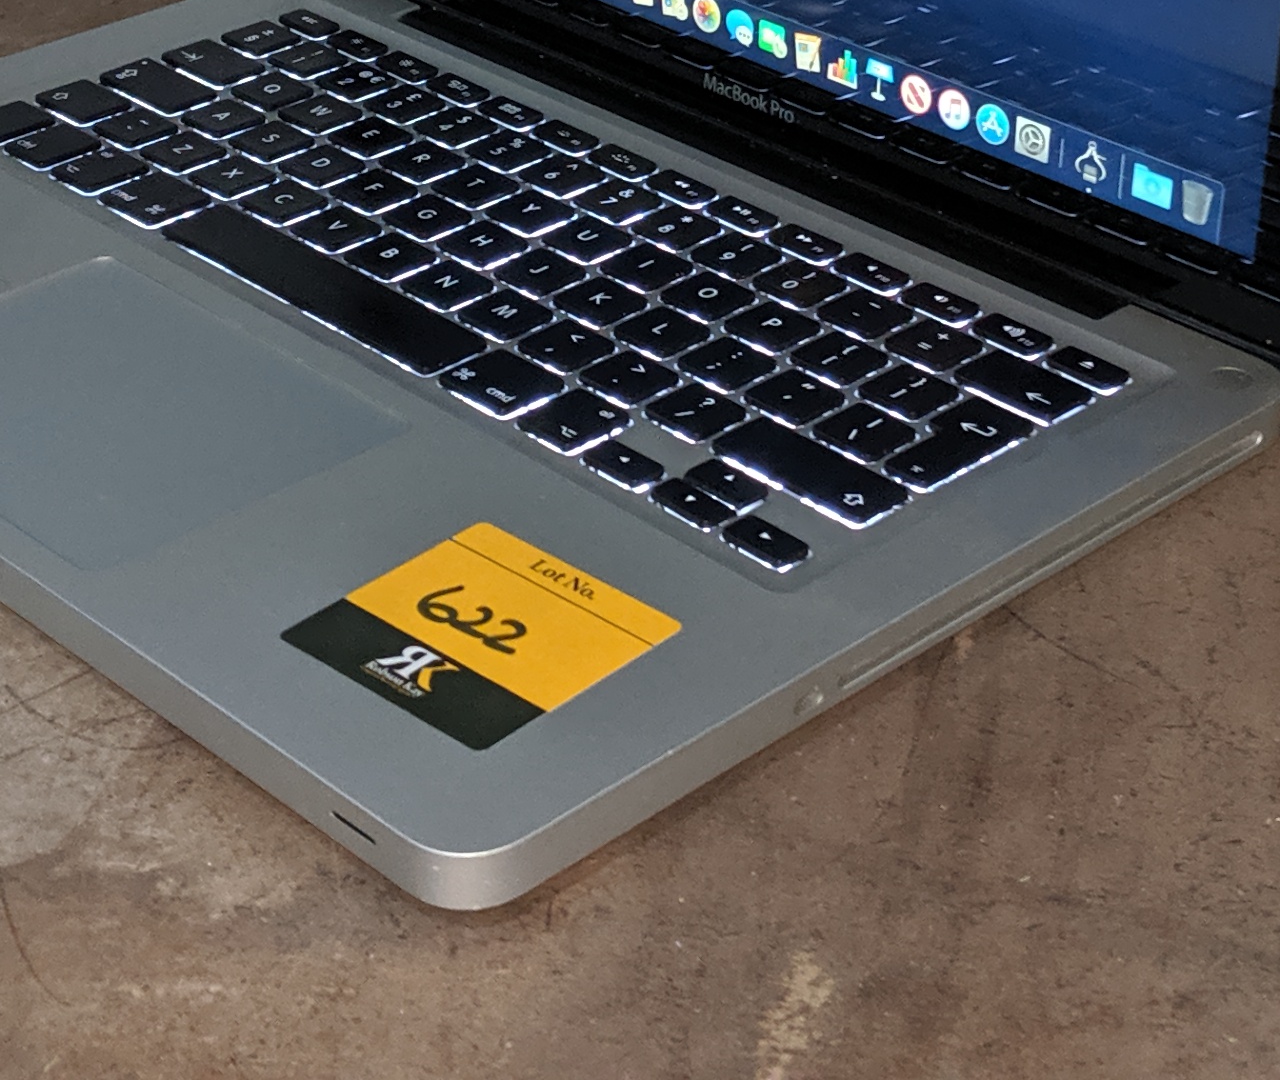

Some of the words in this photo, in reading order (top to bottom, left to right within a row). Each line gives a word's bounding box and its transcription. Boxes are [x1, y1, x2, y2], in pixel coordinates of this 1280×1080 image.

[263, 83, 282, 95] Q
[703, 72, 768, 114] MacBook
[770, 99, 796, 124] Pro
[386, 100, 403, 109] 3
[211, 111, 231, 121] A
[309, 104, 333, 117] W
[438, 123, 455, 132] 4
[261, 133, 281, 143] S
[361, 129, 381, 139] E
[172, 143, 194, 155] Z
[489, 146, 508, 156] 5
[310, 157, 331, 168] D
[411, 153, 432, 164] R
[220, 167, 244, 179] X
[543, 171, 561, 180] 6
[363, 182, 385, 191] F
[466, 177, 486, 188] T
[274, 194, 294, 205] C
[599, 196, 619, 205] 7
[521, 203, 542, 213] Y
[416, 209, 438, 220] G
[327, 219, 348, 230] V
[657, 224, 676, 234] 8
[469, 234, 494, 247] H
[576, 229, 599, 242] U
[379, 247, 400, 259] B
[718, 251, 737, 261] 9
[528, 265, 550, 274] J
[434, 275, 459, 289] N
[588, 292, 612, 305] K
[697, 287, 719, 299] O
[490, 304, 518, 319] M
[760, 317, 783, 327] P
[651, 322, 668, 335] L
[485, 387, 517, 404] cmd
[529, 558, 565, 584] Lot
[565, 576, 595, 601] No.
[416, 584, 528, 655] 622
